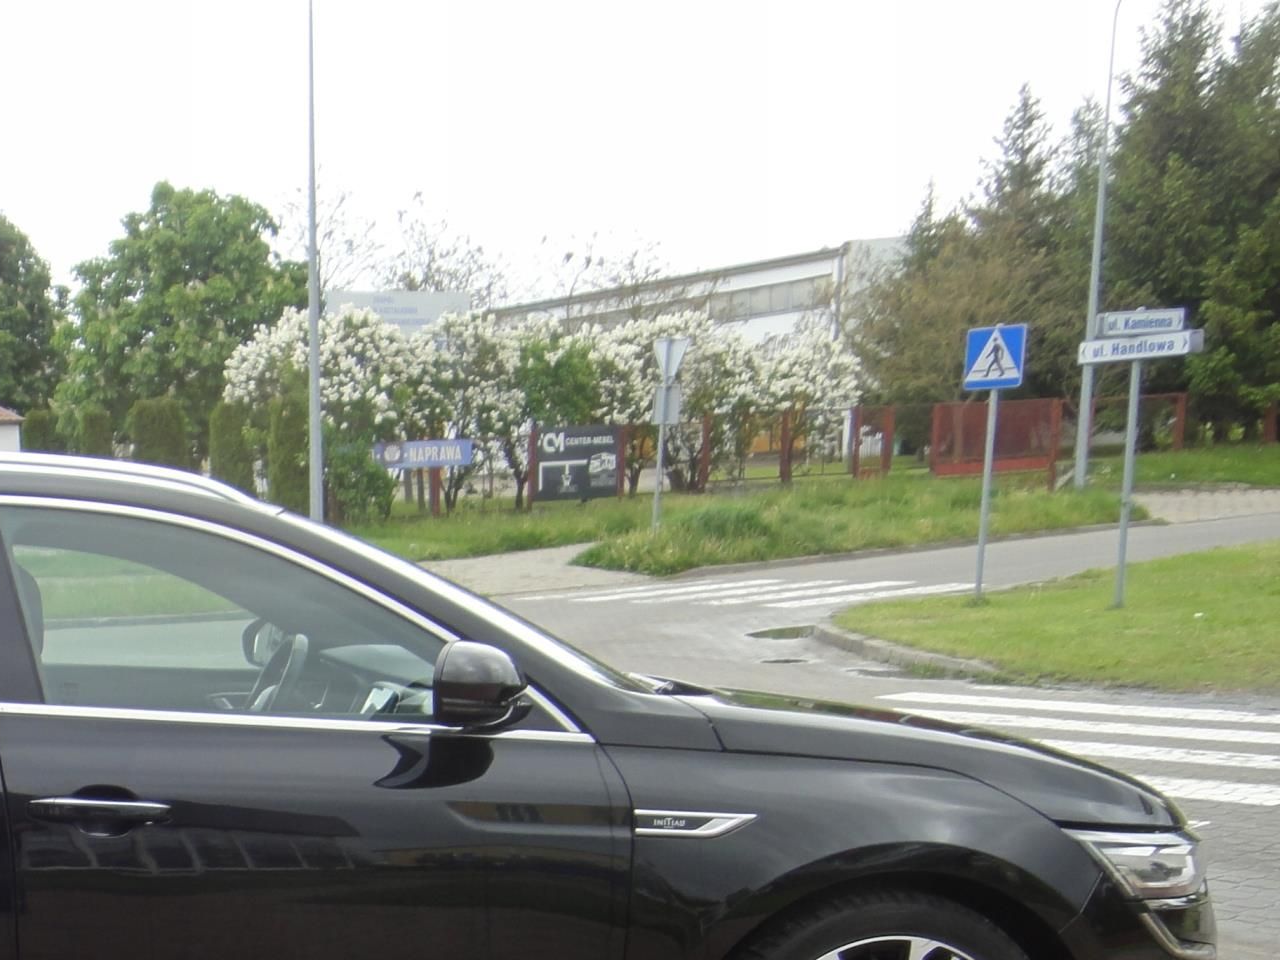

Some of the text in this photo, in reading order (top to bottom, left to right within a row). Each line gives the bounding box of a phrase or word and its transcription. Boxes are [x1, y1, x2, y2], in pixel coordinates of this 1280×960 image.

[1124, 315, 1173, 330] Kamienna
[1092, 339, 1175, 358] ul. Handlowa
[409, 445, 462, 462] NAPRAWA
